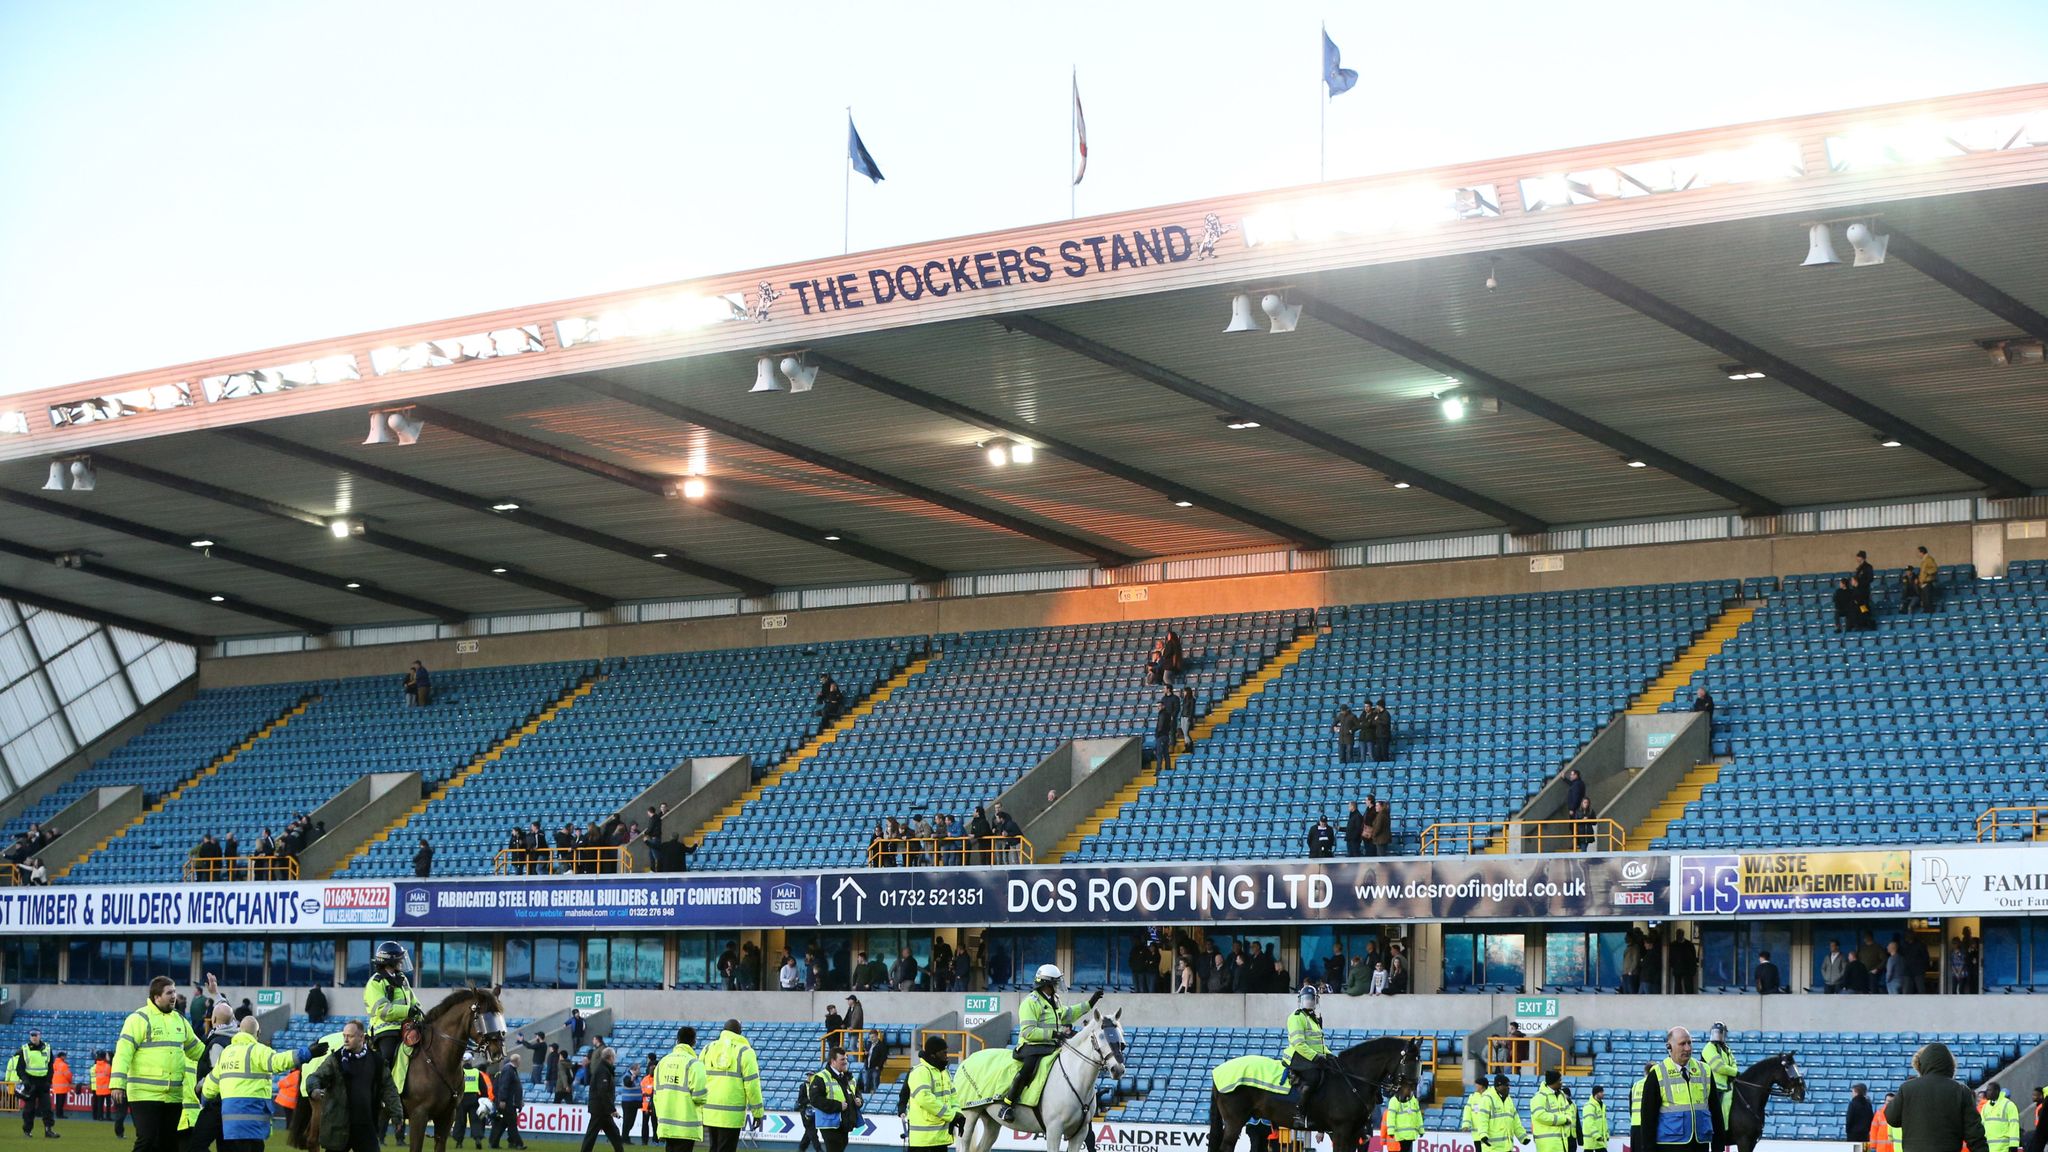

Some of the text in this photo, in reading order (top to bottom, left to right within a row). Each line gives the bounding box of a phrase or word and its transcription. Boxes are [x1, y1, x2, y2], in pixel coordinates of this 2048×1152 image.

[790, 225, 1193, 315] THE DOCKERS STAND
[1622, 860, 1648, 880] CHAS
[1744, 855, 1807, 873] WASTE
[1355, 878, 1586, 901] www.dcsroofingltd.co.uk
[1680, 855, 1741, 914] RTS
[1744, 873, 1876, 893] MANAGEMENT
[1983, 873, 2048, 891] FAMI
[325, 888, 388, 907] 01689-762222
[410, 892, 426, 901] MAH
[437, 886, 761, 908] FABRICATED STEEL FOR GENERAL BUILDERS & LOFT CONVERTORS
[776, 887, 796, 898] MAH
[879, 887, 984, 907] 01732 521351
[1007, 873, 1334, 914] DCS ROOFING LTD
[1745, 893, 1904, 910] www.rtswaste.co.uk
[17, 893, 77, 925] TIMBER
[83, 893, 94, 925] &
[101, 892, 182, 925] BUILDERS
[188, 890, 299, 925] MERCHANTS
[408, 904, 428, 912] STEEL
[564, 908, 609, 917] mahsteel.com
[629, 908, 648, 917] 01322
[649, 907, 661, 916] 276
[774, 901, 798, 911] STEEL
[258, 993, 273, 1002] EXIT
[575, 995, 592, 1005] EXIT
[966, 999, 987, 1009] EXIT
[1518, 1002, 1543, 1013] EXIT
[221, 1061, 240, 1070] WISE
